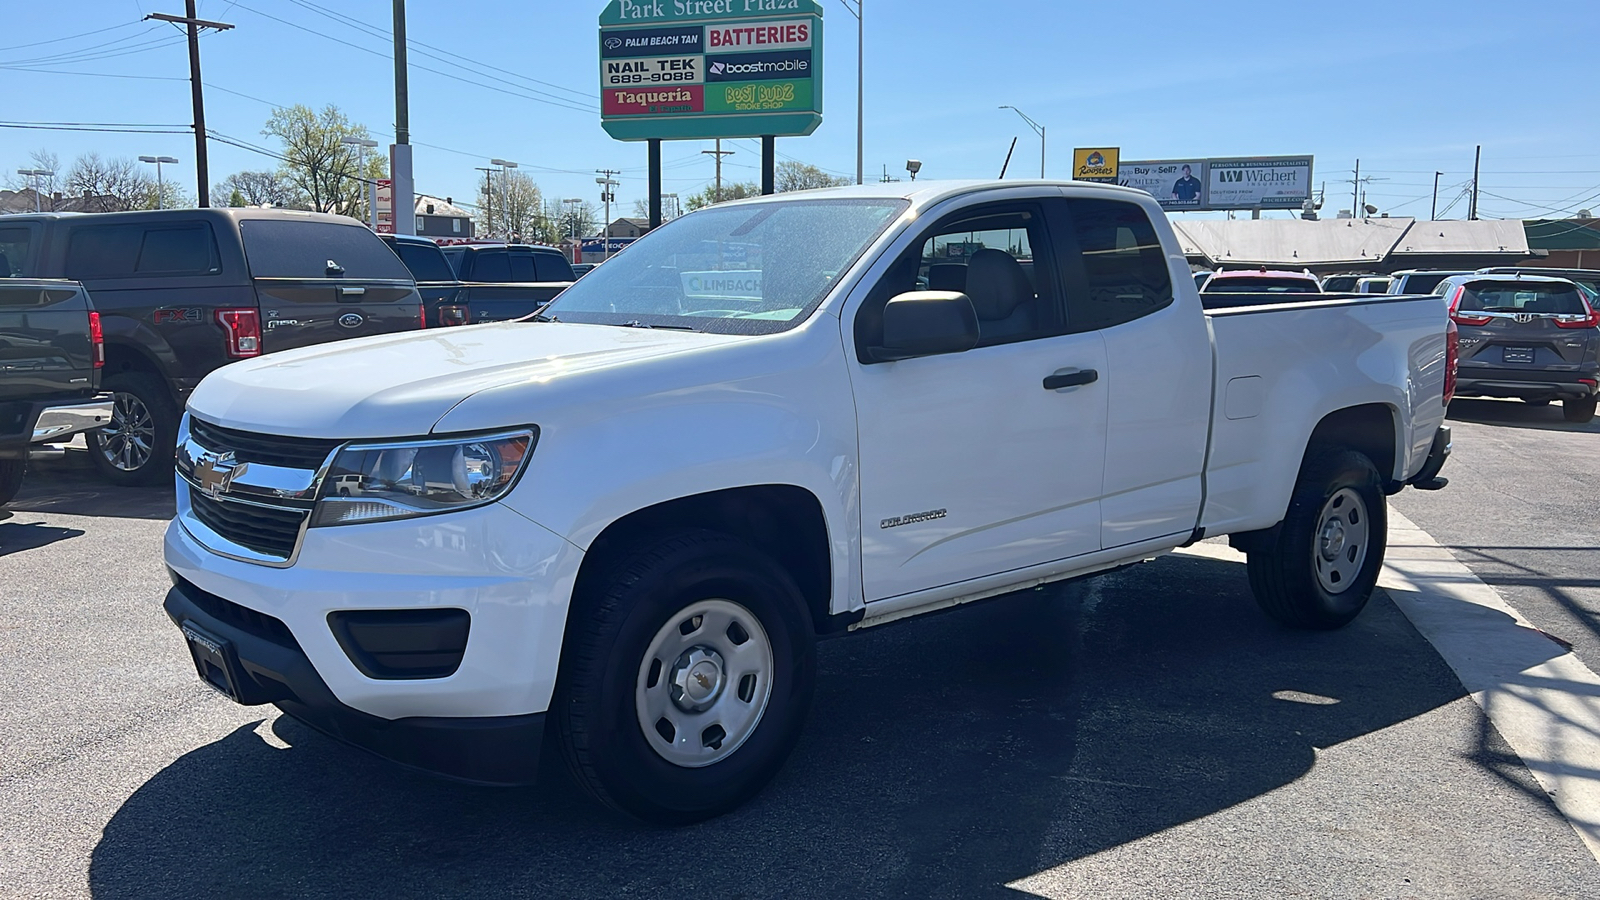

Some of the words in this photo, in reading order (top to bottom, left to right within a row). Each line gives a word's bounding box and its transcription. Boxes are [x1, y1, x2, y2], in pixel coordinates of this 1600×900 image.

[619, 0, 665, 19] Park
[673, 0, 733, 16] Street
[625, 37, 649, 47] PALM
[650, 36, 679, 46] BEACH
[680, 35, 698, 44] TAN
[709, 24, 809, 47] BATTERIES
[608, 61, 649, 74] NAIL
[657, 59, 695, 71] TEK
[610, 72, 695, 84] 689-9088
[758, 82, 795, 102] BUDZ
[735, 102, 761, 110] SMOKE
[762, 101, 784, 109] SHOP
[1078, 165, 1113, 177] Roosters
[1134, 167, 1150, 175] Buy
[1158, 166, 1177, 174] Sell?
[1245, 169, 1297, 182] Wichert
[153, 307, 202, 326] FX4
[880, 508, 947, 529] COLORADO
